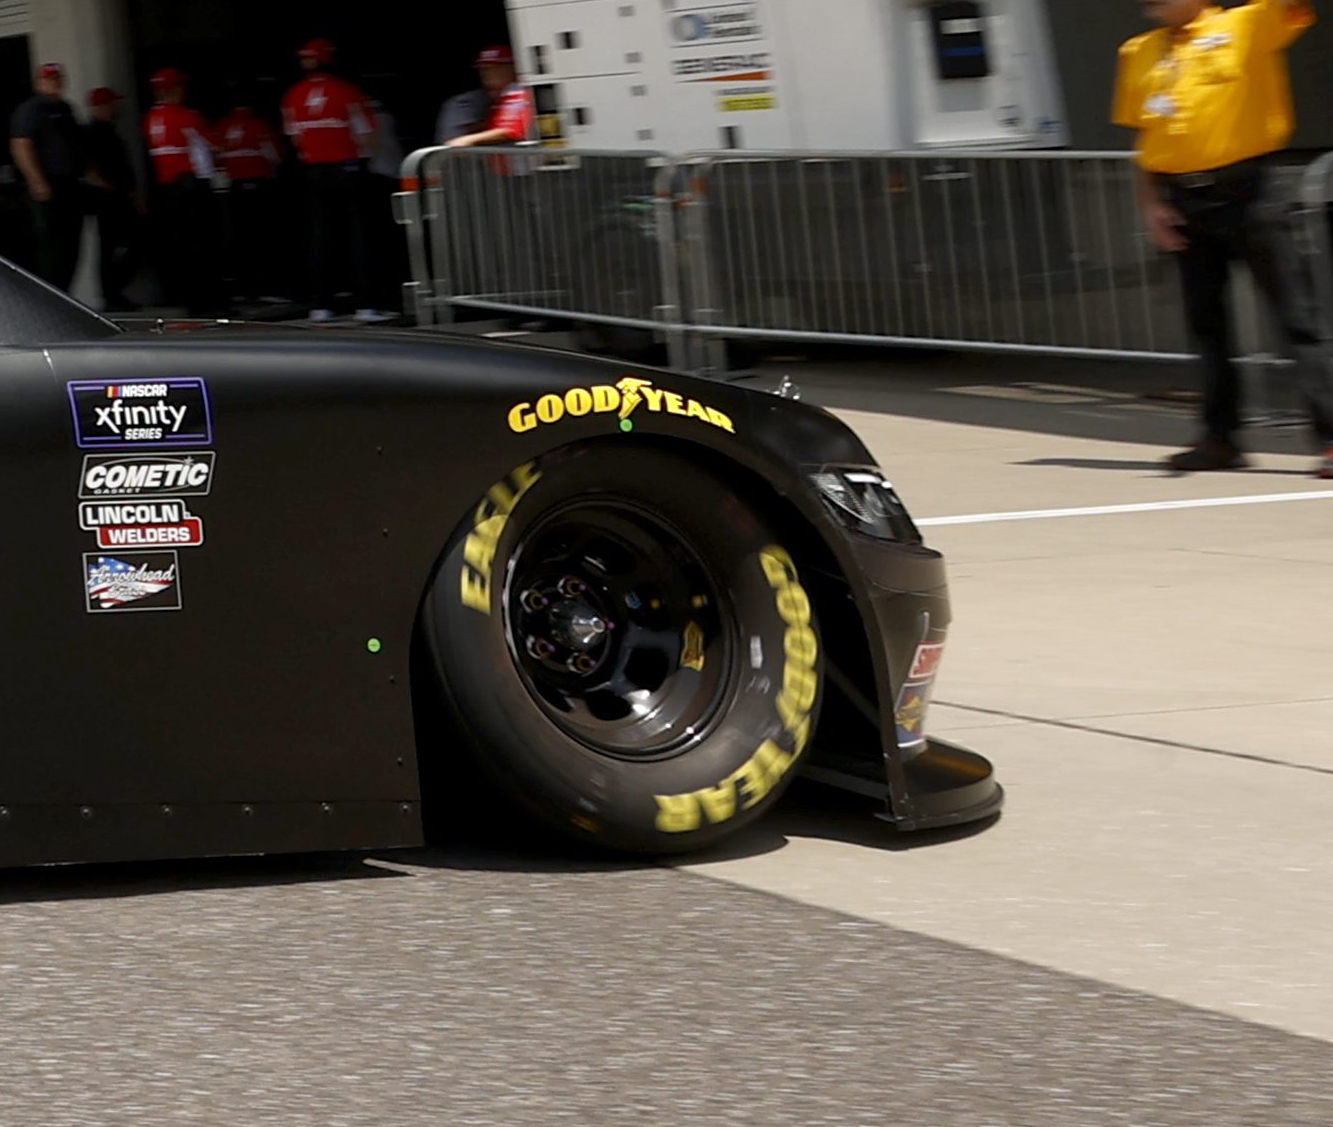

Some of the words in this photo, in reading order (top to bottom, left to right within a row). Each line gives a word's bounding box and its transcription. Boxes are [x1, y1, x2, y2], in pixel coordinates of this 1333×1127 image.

[120, 384, 168, 398] NASCAR
[94, 399, 187, 434] xfinity
[507, 382, 736, 434] GOODYEAR
[124, 427, 163, 441] SERIES
[85, 462, 210, 490] COMETIC
[93, 487, 141, 495] GASKET
[86, 504, 179, 525] LINCOLN
[108, 527, 191, 544] WELDERS
[86, 562, 175, 585] Arrowhead
